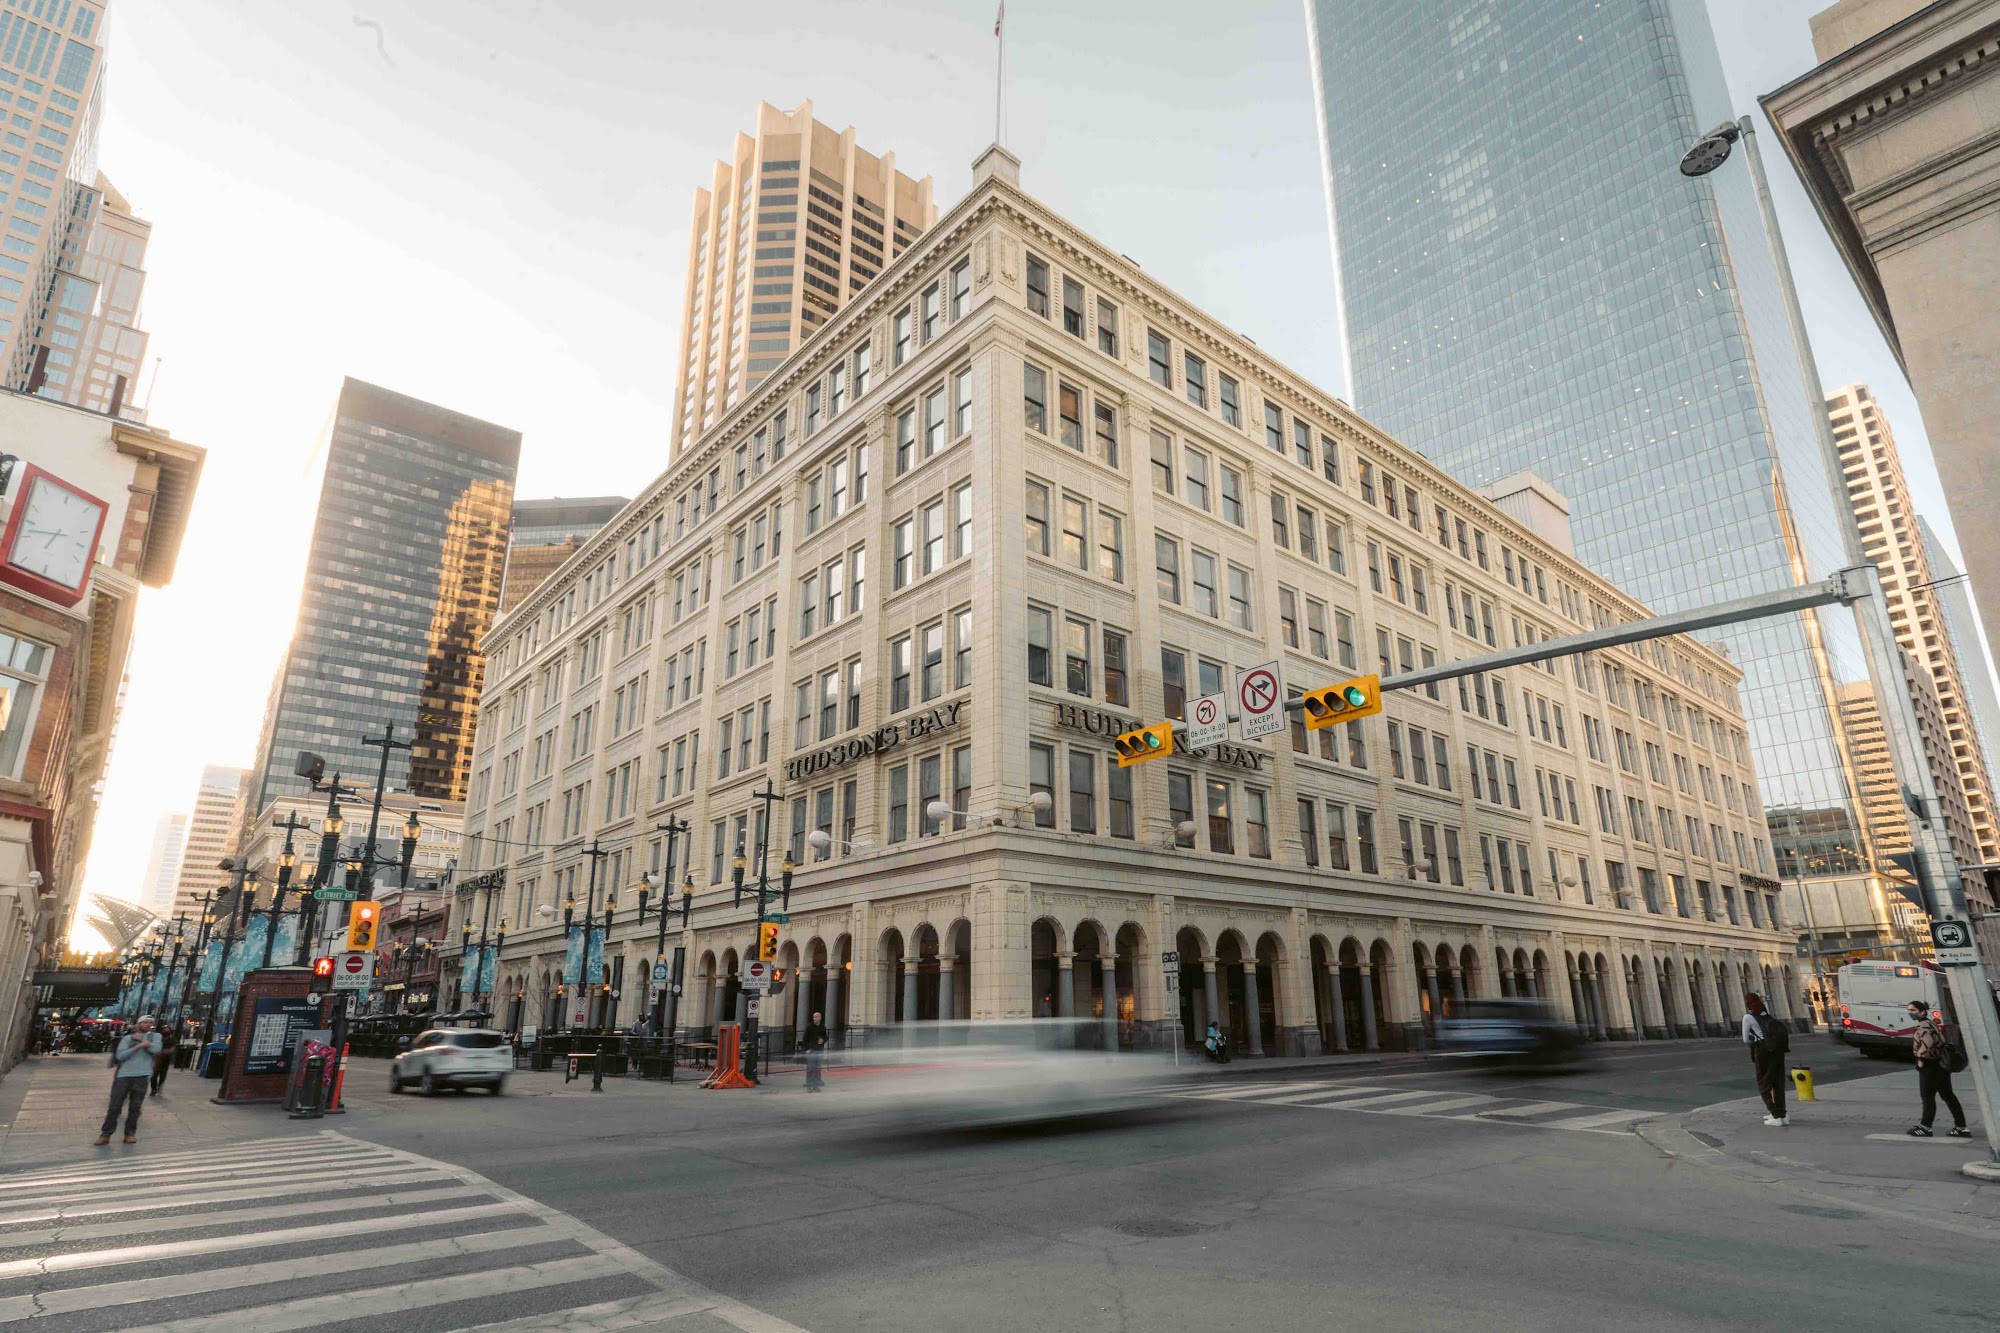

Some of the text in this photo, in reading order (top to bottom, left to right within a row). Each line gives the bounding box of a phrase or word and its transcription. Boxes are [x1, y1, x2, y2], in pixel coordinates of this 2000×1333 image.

[1249, 713, 1274, 726] EXCEPT
[1190, 723, 1226, 738] 06:00-18:00
[1247, 721, 1280, 736] BICYCLES
[785, 700, 962, 781] HUDSON'S BAY
[1192, 737, 1204, 746] EXCEPT
[1212, 732, 1226, 740] PERMIT
[1217, 743, 1265, 770] BAY
[324, 891, 342, 899] STREET
